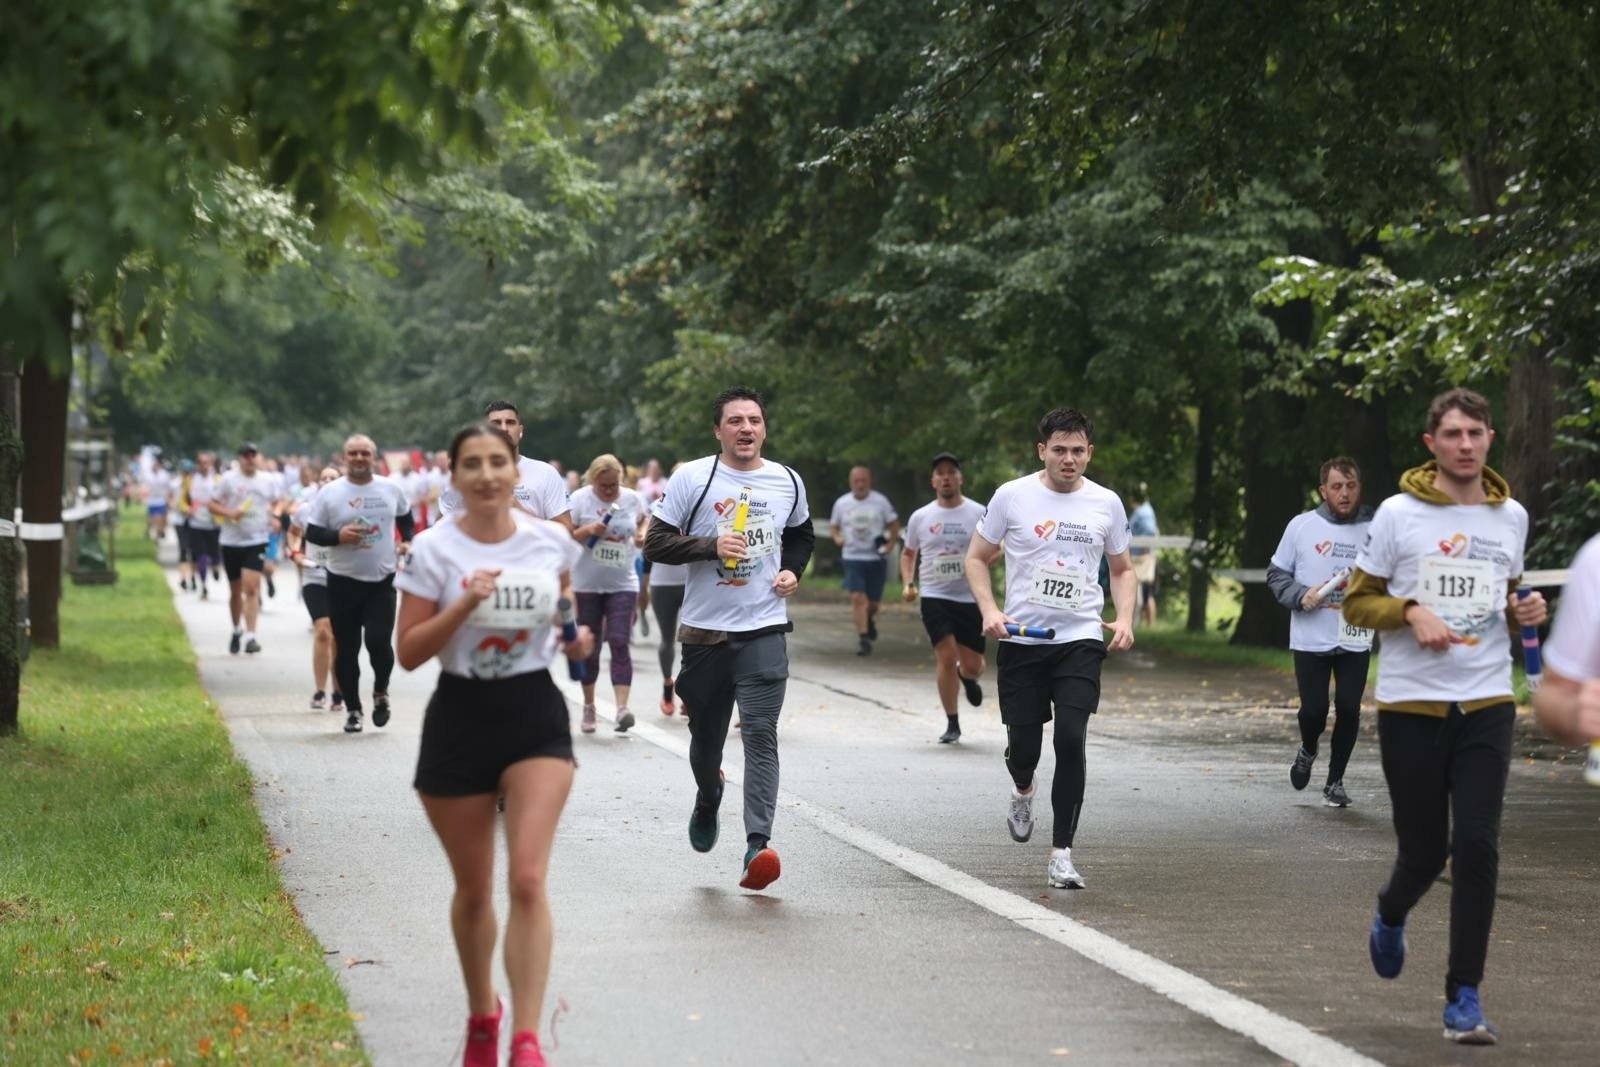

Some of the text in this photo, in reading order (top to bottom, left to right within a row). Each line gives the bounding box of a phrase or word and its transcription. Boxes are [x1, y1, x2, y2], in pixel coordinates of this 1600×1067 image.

[748, 500, 768, 508] land
[1058, 521, 1087, 530] Poland
[743, 528, 765, 547] 84
[1073, 535, 1094, 544] 2023
[1042, 578, 1074, 599] 1722
[1437, 574, 1475, 598] 1137
[493, 586, 535, 610] 1112
